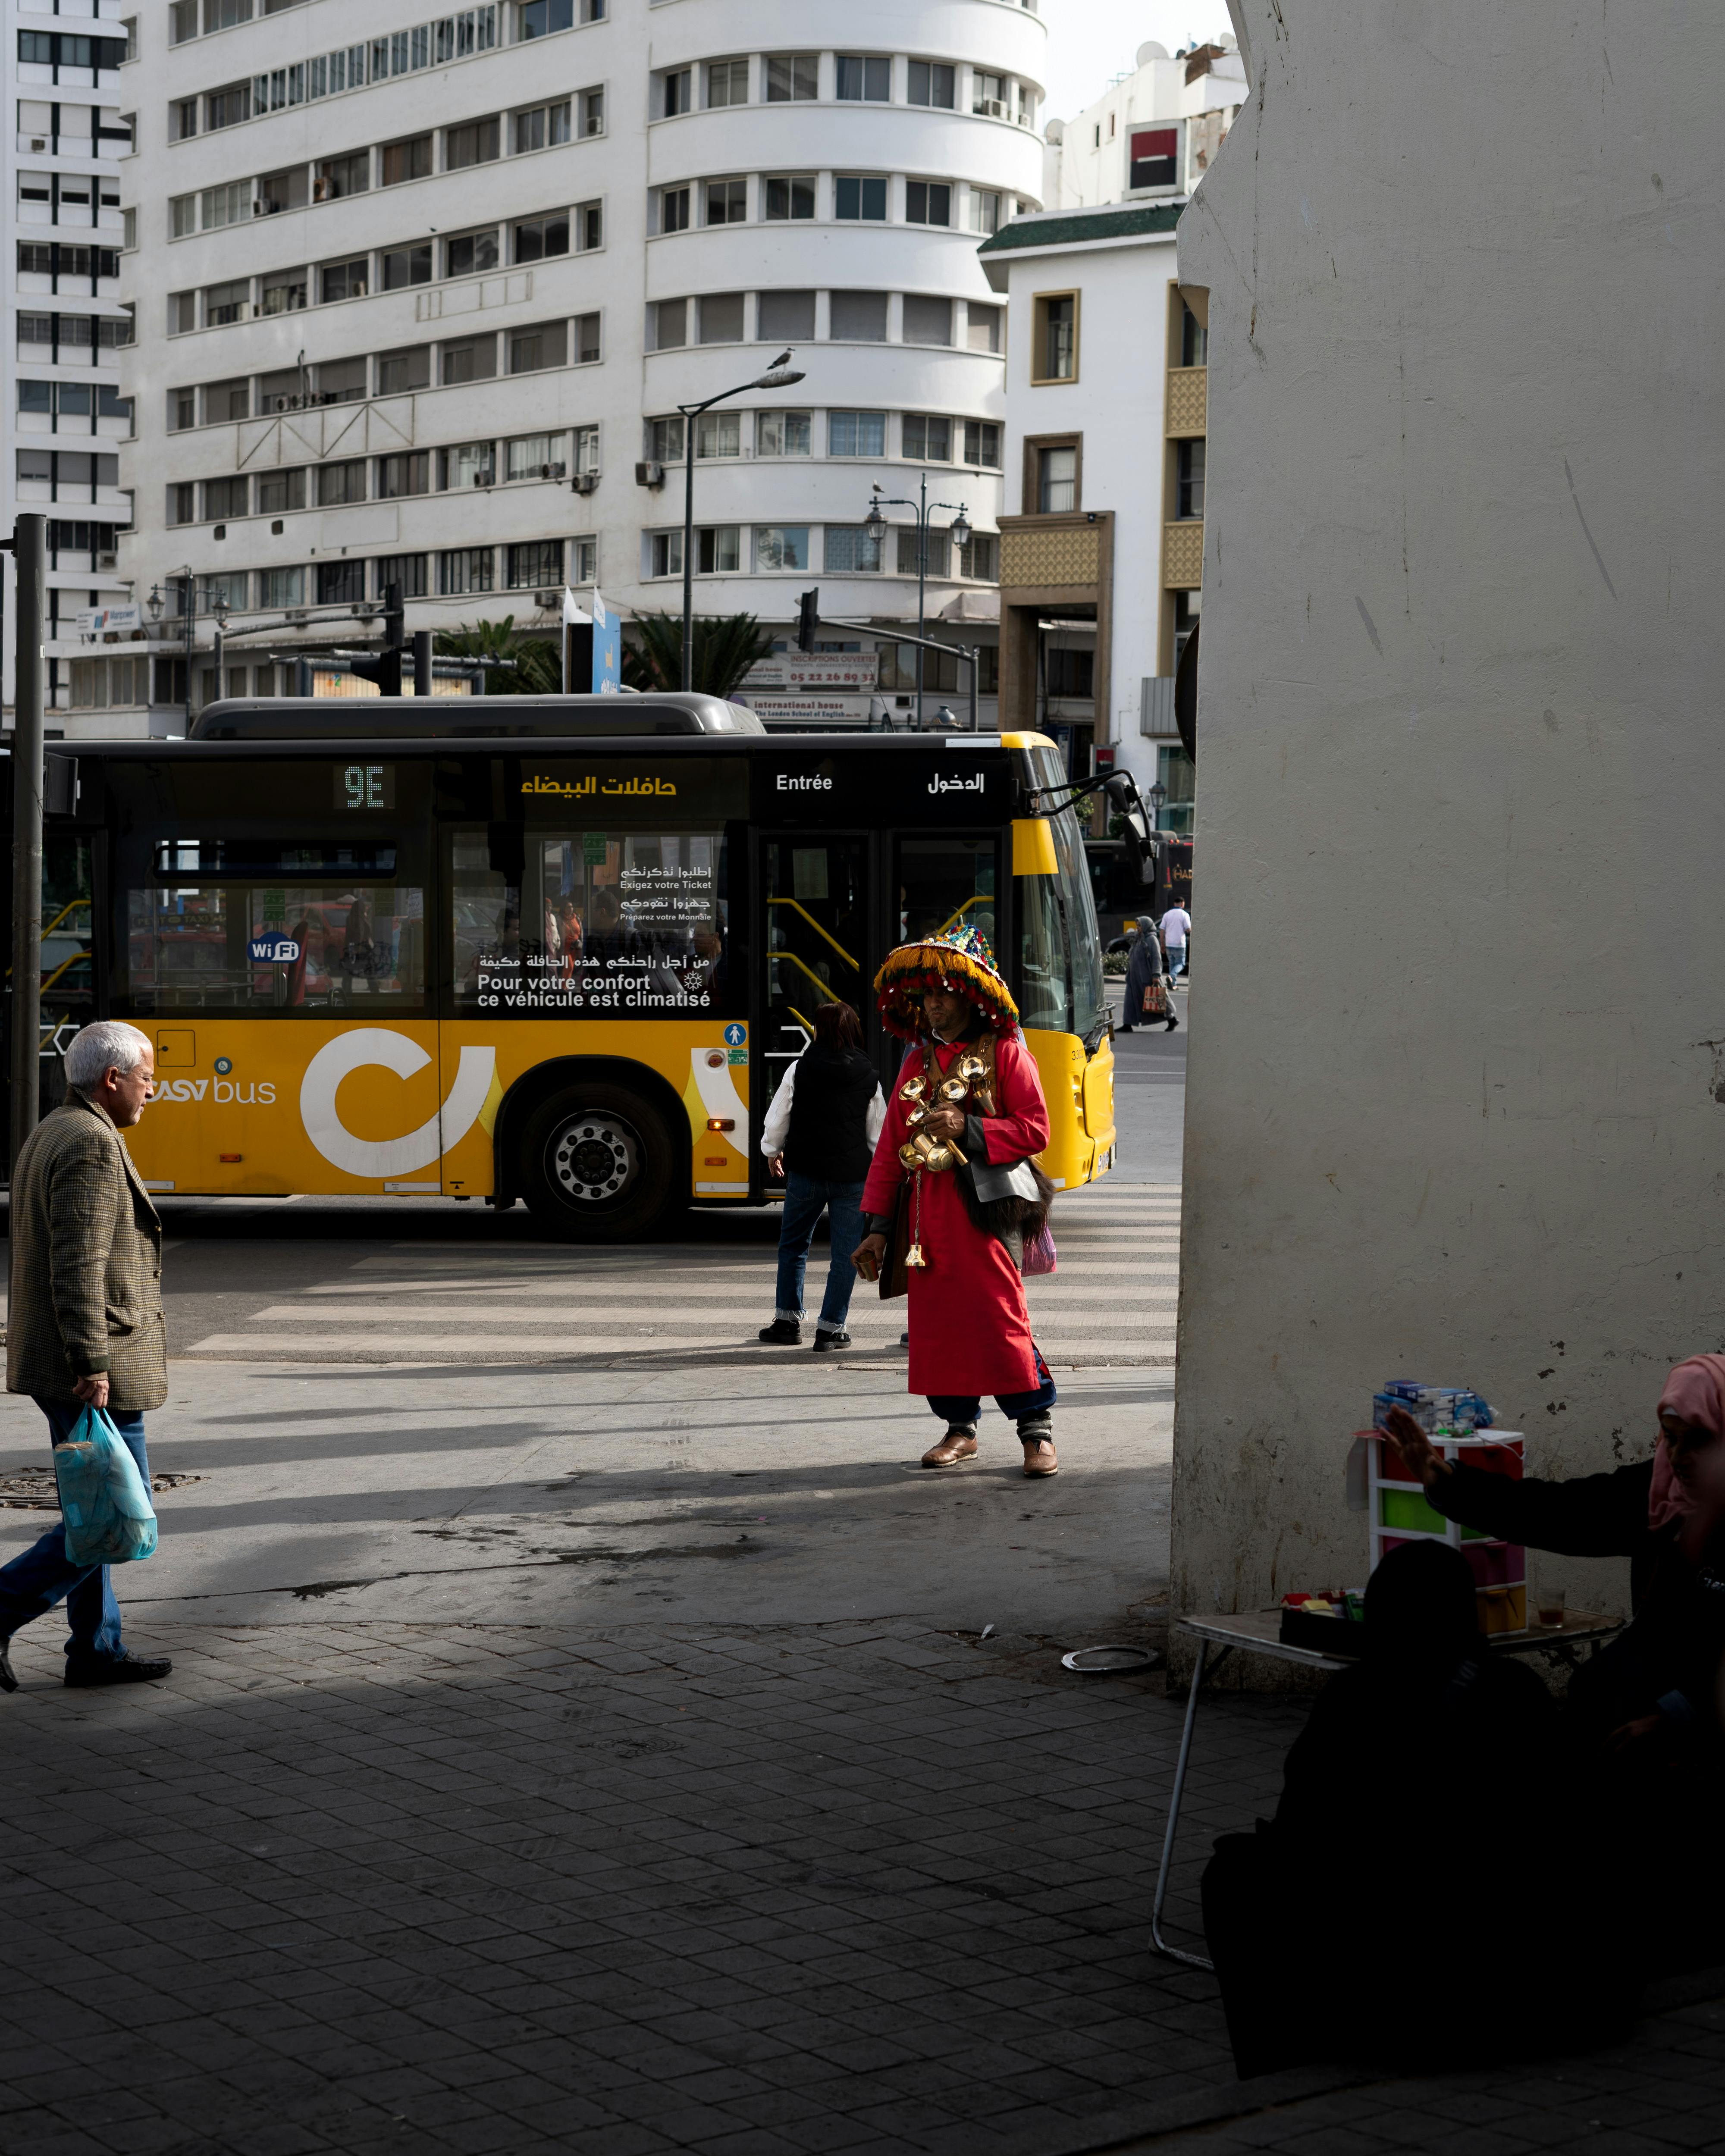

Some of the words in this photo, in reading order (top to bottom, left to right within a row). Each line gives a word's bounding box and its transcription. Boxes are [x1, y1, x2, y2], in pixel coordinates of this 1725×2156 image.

[790, 673, 805, 681] 05
[808, 673, 822, 681] 22
[826, 673, 841, 681] 26
[844, 673, 858, 682] 89
[862, 673, 875, 682] 32
[345, 766, 384, 807] 9E
[521, 776, 596, 798] البيضاء
[602, 777, 677, 795] حافلات
[777, 774, 832, 790] Entrée
[928, 773, 984, 794] الدخول
[621, 866, 674, 878] تذكرتكم
[678, 867, 711, 878] اطلبوا
[621, 881, 652, 890] Exigez
[621, 897, 668, 909] نقودكم
[674, 897, 711, 909] جهزوا
[480, 955, 521, 969] مكيفة
[527, 955, 568, 968] الحافلة
[574, 956, 600, 966] هذه
[606, 955, 656, 969] راحتكم
[662, 955, 687, 969] أجل
[693, 955, 710, 969] من
[478, 975, 522, 990] Pour
[527, 975, 576, 990] votre
[582, 975, 650, 990] confort
[478, 995, 499, 1006] ce
[505, 991, 583, 1006] véhicule
[590, 992, 619, 1006] est
[625, 990, 711, 1006] climatisé
[213, 1076, 276, 1104] bus
